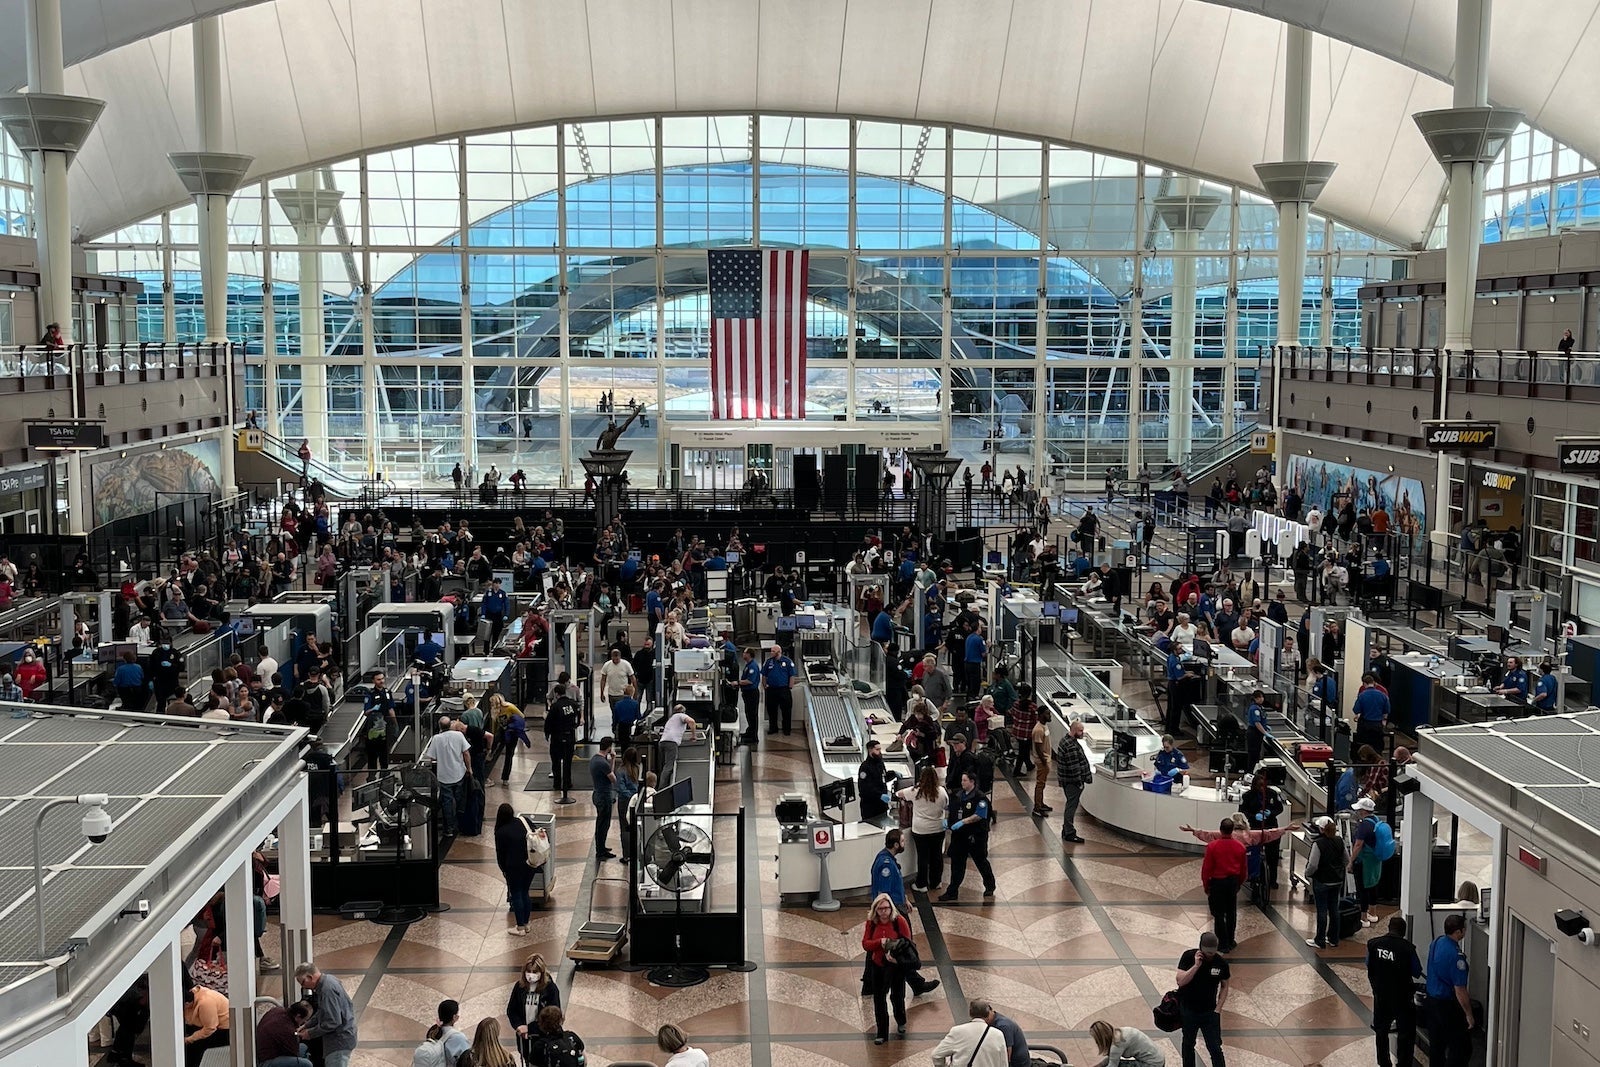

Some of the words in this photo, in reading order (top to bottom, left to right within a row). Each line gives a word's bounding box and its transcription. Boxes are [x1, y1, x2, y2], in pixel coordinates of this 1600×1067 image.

[1429, 431, 1493, 443] SUBWAY
[1564, 450, 1600, 464] SUB
[1, 479, 10, 490] TSA
[11, 478, 19, 489] Pre
[1482, 472, 1516, 490] SUBWAY
[562, 705, 574, 715] TSA
[1377, 948, 1394, 961] TSA
